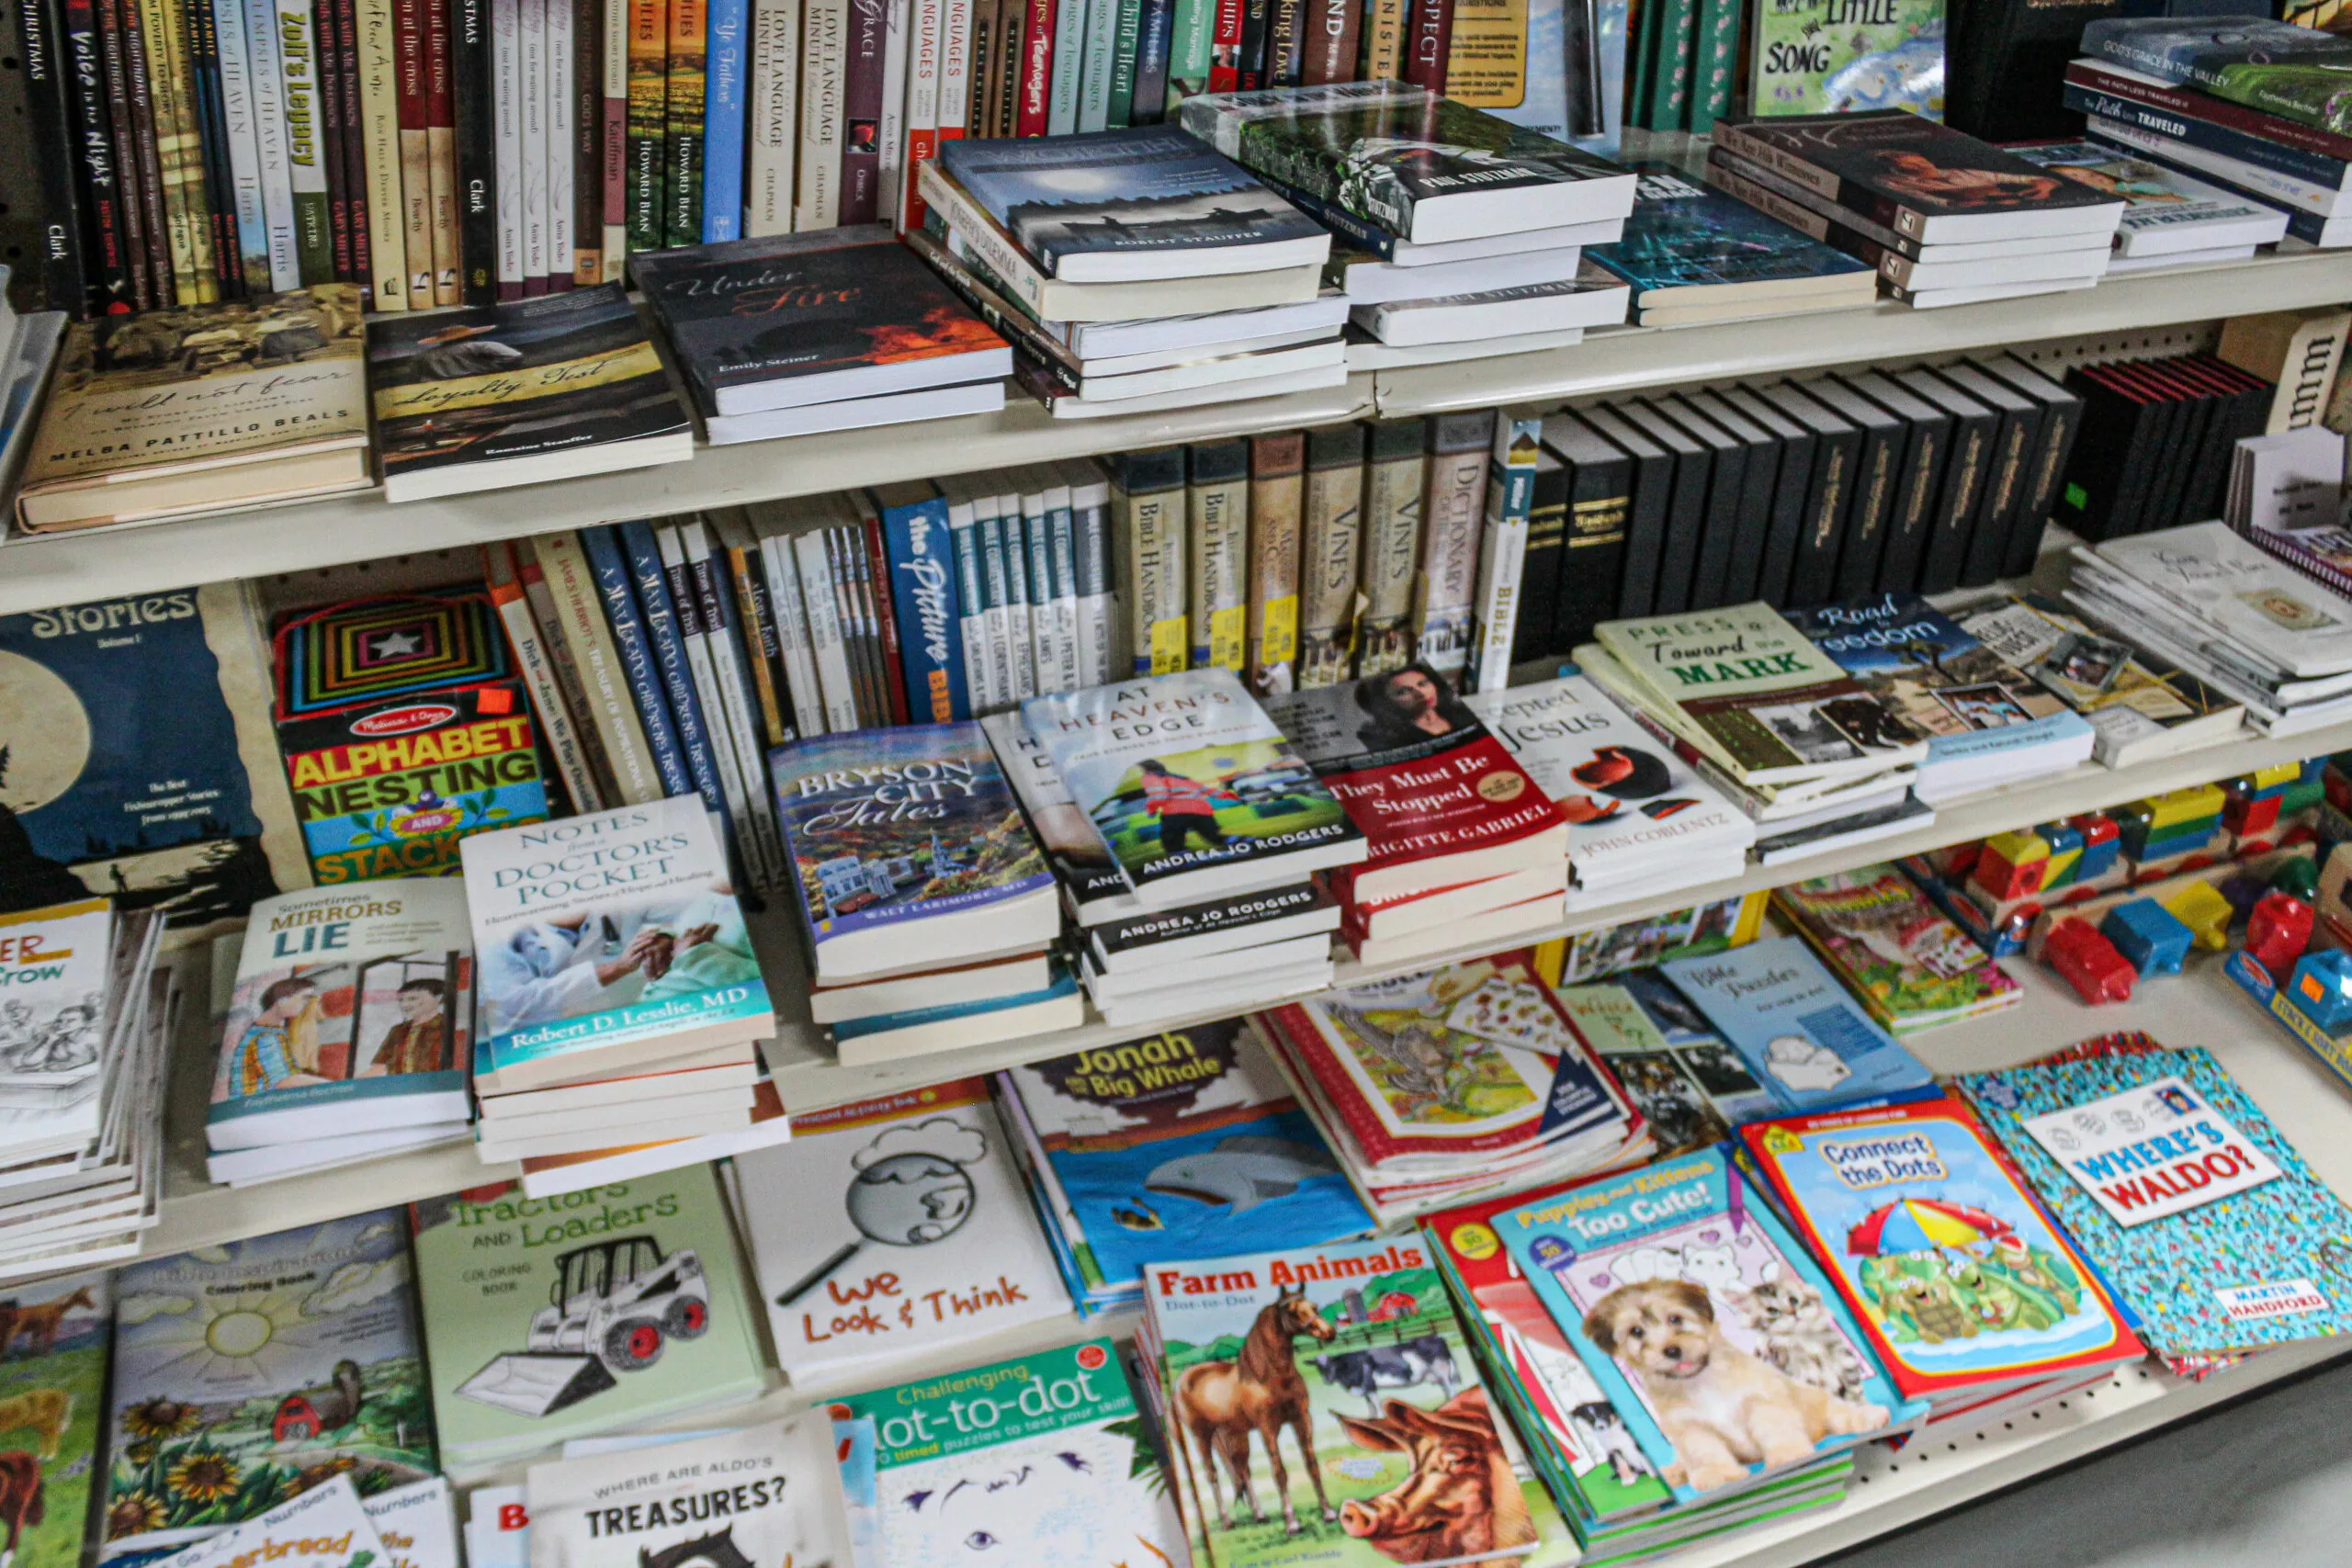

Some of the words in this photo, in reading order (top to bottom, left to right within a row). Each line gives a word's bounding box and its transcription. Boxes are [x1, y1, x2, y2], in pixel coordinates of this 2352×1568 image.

[773, 9, 786, 52] LOVE
[823, 8, 838, 52] LOVE
[1824, 0, 1898, 26] LITTLE
[150, 12, 164, 60] POVERTY
[280, 12, 304, 77] Zoll's
[402, 35, 418, 56] the
[431, 33, 447, 54] the
[756, 9, 770, 71] MINUTE
[808, 6, 821, 68] MINUTE
[1765, 41, 1830, 74] SONG
[405, 61, 416, 96] cross
[433, 59, 445, 94] cross
[1026, 35, 1050, 116] Teenagers
[1115, 53, 1134, 93] Heart
[2103, 40, 2133, 61] GOD'S
[2132, 50, 2161, 68] GRACE
[2194, 68, 2231, 88] VALLEY
[71, 31, 96, 86] Voice
[85, 130, 111, 186] Night
[225, 62, 247, 134] HEAVEN
[770, 58, 786, 149] LANGUAGE
[820, 56, 836, 147] LANGUAGE
[2095, 96, 2121, 117] Path
[2137, 111, 2188, 138] TRAVELED
[261, 101, 278, 171] HEAVEN
[288, 82, 316, 167] Legacy
[608, 119, 621, 182] Kauffman
[640, 141, 652, 192] HOWARD
[680, 136, 692, 189] HOWARD
[470, 179, 483, 213] Clark
[764, 167, 775, 222] CHAPMAN
[814, 164, 824, 220] CHAPMAN
[1418, 173, 1464, 189] PAUL
[1467, 165, 1539, 185] STUTZMAN
[239, 177, 254, 226] Harris
[411, 197, 421, 234] Beachy
[639, 196, 649, 232] BEAN
[679, 194, 688, 229] BEAN
[1366, 197, 1400, 224] STUTZMAN
[49, 226, 62, 260] Clark
[1114, 235, 1183, 248] ROBERT
[1186, 230, 1263, 244] STAUFFER
[1324, 208, 1368, 241] STUTZMAN
[274, 226, 288, 273] Harris
[665, 268, 803, 299] Under
[731, 286, 862, 319] Fire
[393, 379, 524, 408] Loyalty
[539, 359, 619, 387] Test
[718, 359, 763, 374] Emily
[765, 352, 820, 368] Steiner
[92, 392, 178, 415] will
[186, 381, 254, 401] not
[259, 371, 355, 396] fear
[49, 442, 130, 462] MELBA
[145, 422, 261, 449] PATTILLO
[275, 409, 350, 428] BEALS
[909, 515, 932, 557] the
[1139, 502, 1160, 548] BIBLE
[1204, 491, 1226, 538] BIBLE
[1443, 463, 1480, 593] DICTIONARY
[605, 582, 628, 623] MAX
[640, 573, 663, 612] MAX
[898, 557, 949, 663] Picture
[1139, 550, 1161, 648] HANDBOOK
[1202, 540, 1225, 637] HANDBOOK
[1816, 592, 1900, 627] Road
[30, 591, 198, 640] Stories
[557, 558, 578, 594] JAMES
[569, 592, 596, 649] HERRIOT'S
[588, 648, 616, 699] TREASURY
[1491, 585, 1514, 647] BIBLE
[1824, 621, 1940, 652] eedom
[521, 638, 541, 671] Dick
[615, 619, 649, 685] LUCADO
[649, 609, 679, 669] LUCADO
[1645, 635, 1747, 664] Toward
[1667, 651, 1815, 686] MARK
[667, 670, 699, 742] CHILDREN'S
[1059, 691, 1233, 734] HEAVEN'S
[1116, 685, 1151, 703] AT
[636, 682, 669, 752] CHILDREN'S
[1111, 714, 1205, 743] EDGE
[1499, 712, 1611, 754] Jesus
[293, 717, 528, 788] ALPHABET
[689, 741, 719, 805] TREASURY
[293, 752, 538, 820] NESTING
[796, 753, 976, 802] BRYSON
[871, 773, 978, 806] CITY
[1329, 778, 1387, 802] They
[1390, 766, 1452, 790] Must
[1454, 754, 1491, 775] Be
[1372, 782, 1475, 817] Stopped
[411, 816, 443, 830] AND
[521, 810, 650, 851] NOTES
[800, 791, 949, 839] Tales
[1458, 803, 1552, 840] GABRIEL
[1580, 829, 1633, 858] JOHN
[1633, 812, 1732, 845] COBLENTZ
[493, 831, 691, 890] DOCTOR'S
[1142, 846, 1224, 876] ANDREA
[1226, 840, 1251, 858] JO
[1256, 822, 1345, 852] RODGERS
[485, 898, 571, 928] Heartwarming
[571, 887, 611, 908] Stories
[667, 868, 716, 888] Healing
[516, 855, 676, 906] POCKET
[268, 899, 402, 934] MIRRORS
[278, 893, 371, 915] Sometimes
[864, 901, 917, 919] WALT
[920, 888, 998, 911] LARIMORE,
[1118, 915, 1193, 942] ANDREA
[1200, 908, 1224, 924] JO
[1226, 889, 1313, 919] RODGERS
[272, 921, 353, 959] LIE
[510, 1019, 588, 1052] Robert
[591, 1013, 616, 1032] D.
[621, 996, 700, 1028] Lesslie,
[701, 986, 750, 1010] MD
[1074, 1032, 1196, 1077] Jonah
[1091, 1070, 1135, 1100] Big
[1136, 1056, 1223, 1091] Whale
[1823, 1135, 1929, 1166] Connect
[1840, 1163, 1883, 1187] the
[1883, 1156, 1942, 1180] Dots
[2072, 1120, 2226, 1183] WHERE'S
[1517, 1191, 1611, 1228] Puppies
[1633, 1161, 1715, 1196] Kittens
[2098, 1143, 2257, 1213] WALDO?
[472, 1231, 512, 1249] AND
[521, 1192, 680, 1248] Loaders
[1567, 1208, 1630, 1239] Too
[1630, 1181, 1713, 1222] Cute!
[205, 1280, 274, 1295] Coloring
[275, 1271, 318, 1286] Book
[462, 1261, 532, 1283] COLORING
[481, 1281, 518, 1296] BOOK
[828, 1271, 902, 1305] We
[1157, 1268, 1258, 1297] Farm
[1270, 1245, 1425, 1288] Animals
[2231, 1283, 2297, 1303] MARTIN
[802, 1305, 891, 1345] Look
[899, 1298, 915, 1328] &
[922, 1276, 1029, 1323] Think
[1164, 1294, 1257, 1312] Dot-to-Dot
[2228, 1292, 2324, 1319] HANDFORD
[896, 1363, 1030, 1406] Challenging
[894, 1442, 940, 1461] timed
[944, 1427, 1001, 1453] puzzles
[1059, 1404, 1094, 1427] your
[593, 1471, 660, 1500] WHERE
[666, 1462, 703, 1482] ARE
[707, 1455, 775, 1475] ALDO'S
[264, 1484, 338, 1529] Numbers
[365, 1488, 437, 1517] Numbers
[584, 1475, 788, 1539] TREASURES?
[380, 1531, 415, 1550] the
